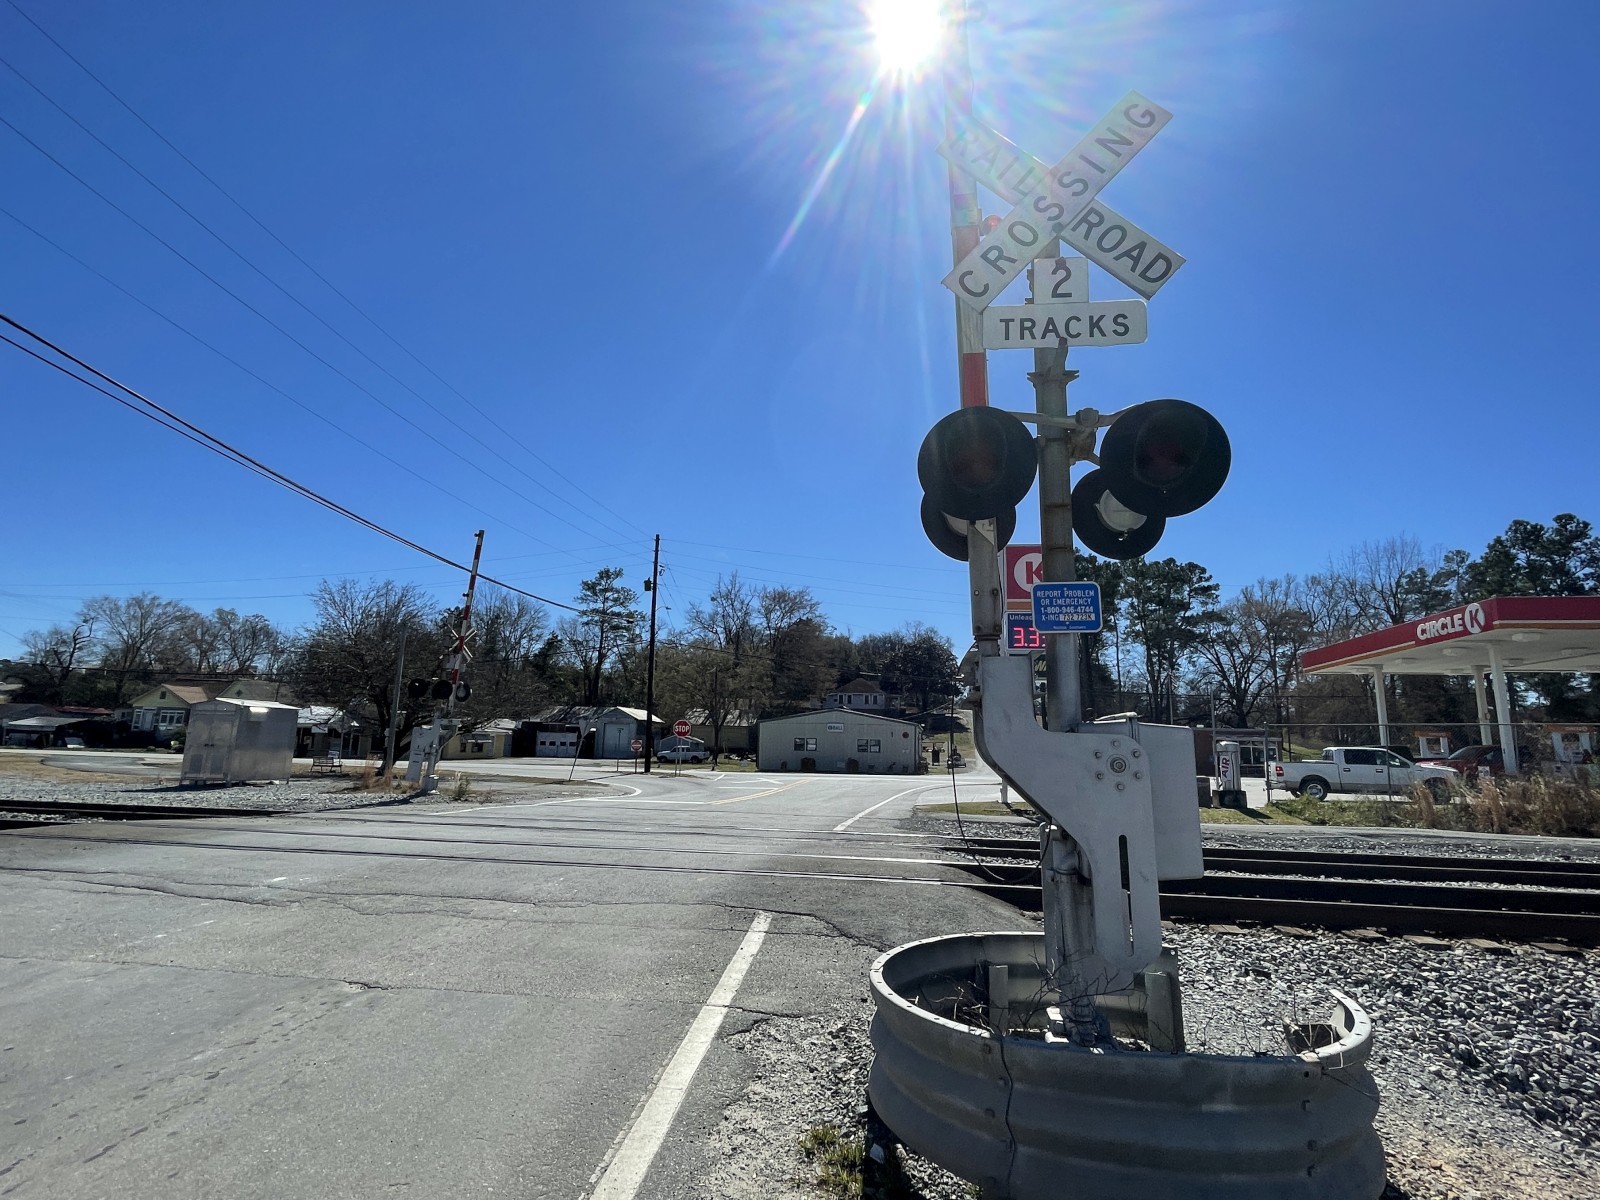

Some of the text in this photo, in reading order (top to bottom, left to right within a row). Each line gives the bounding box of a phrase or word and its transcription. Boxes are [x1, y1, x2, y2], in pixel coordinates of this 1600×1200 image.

[958, 103, 1156, 298] CROSSING
[1070, 206, 1173, 284] ROAD
[1051, 265, 1072, 298] 2
[1000, 313, 1130, 341] TRACKS
[1037, 590, 1061, 598] REPORT
[1416, 613, 1464, 640] CIRCLE
[1221, 757, 1230, 778] AIR
